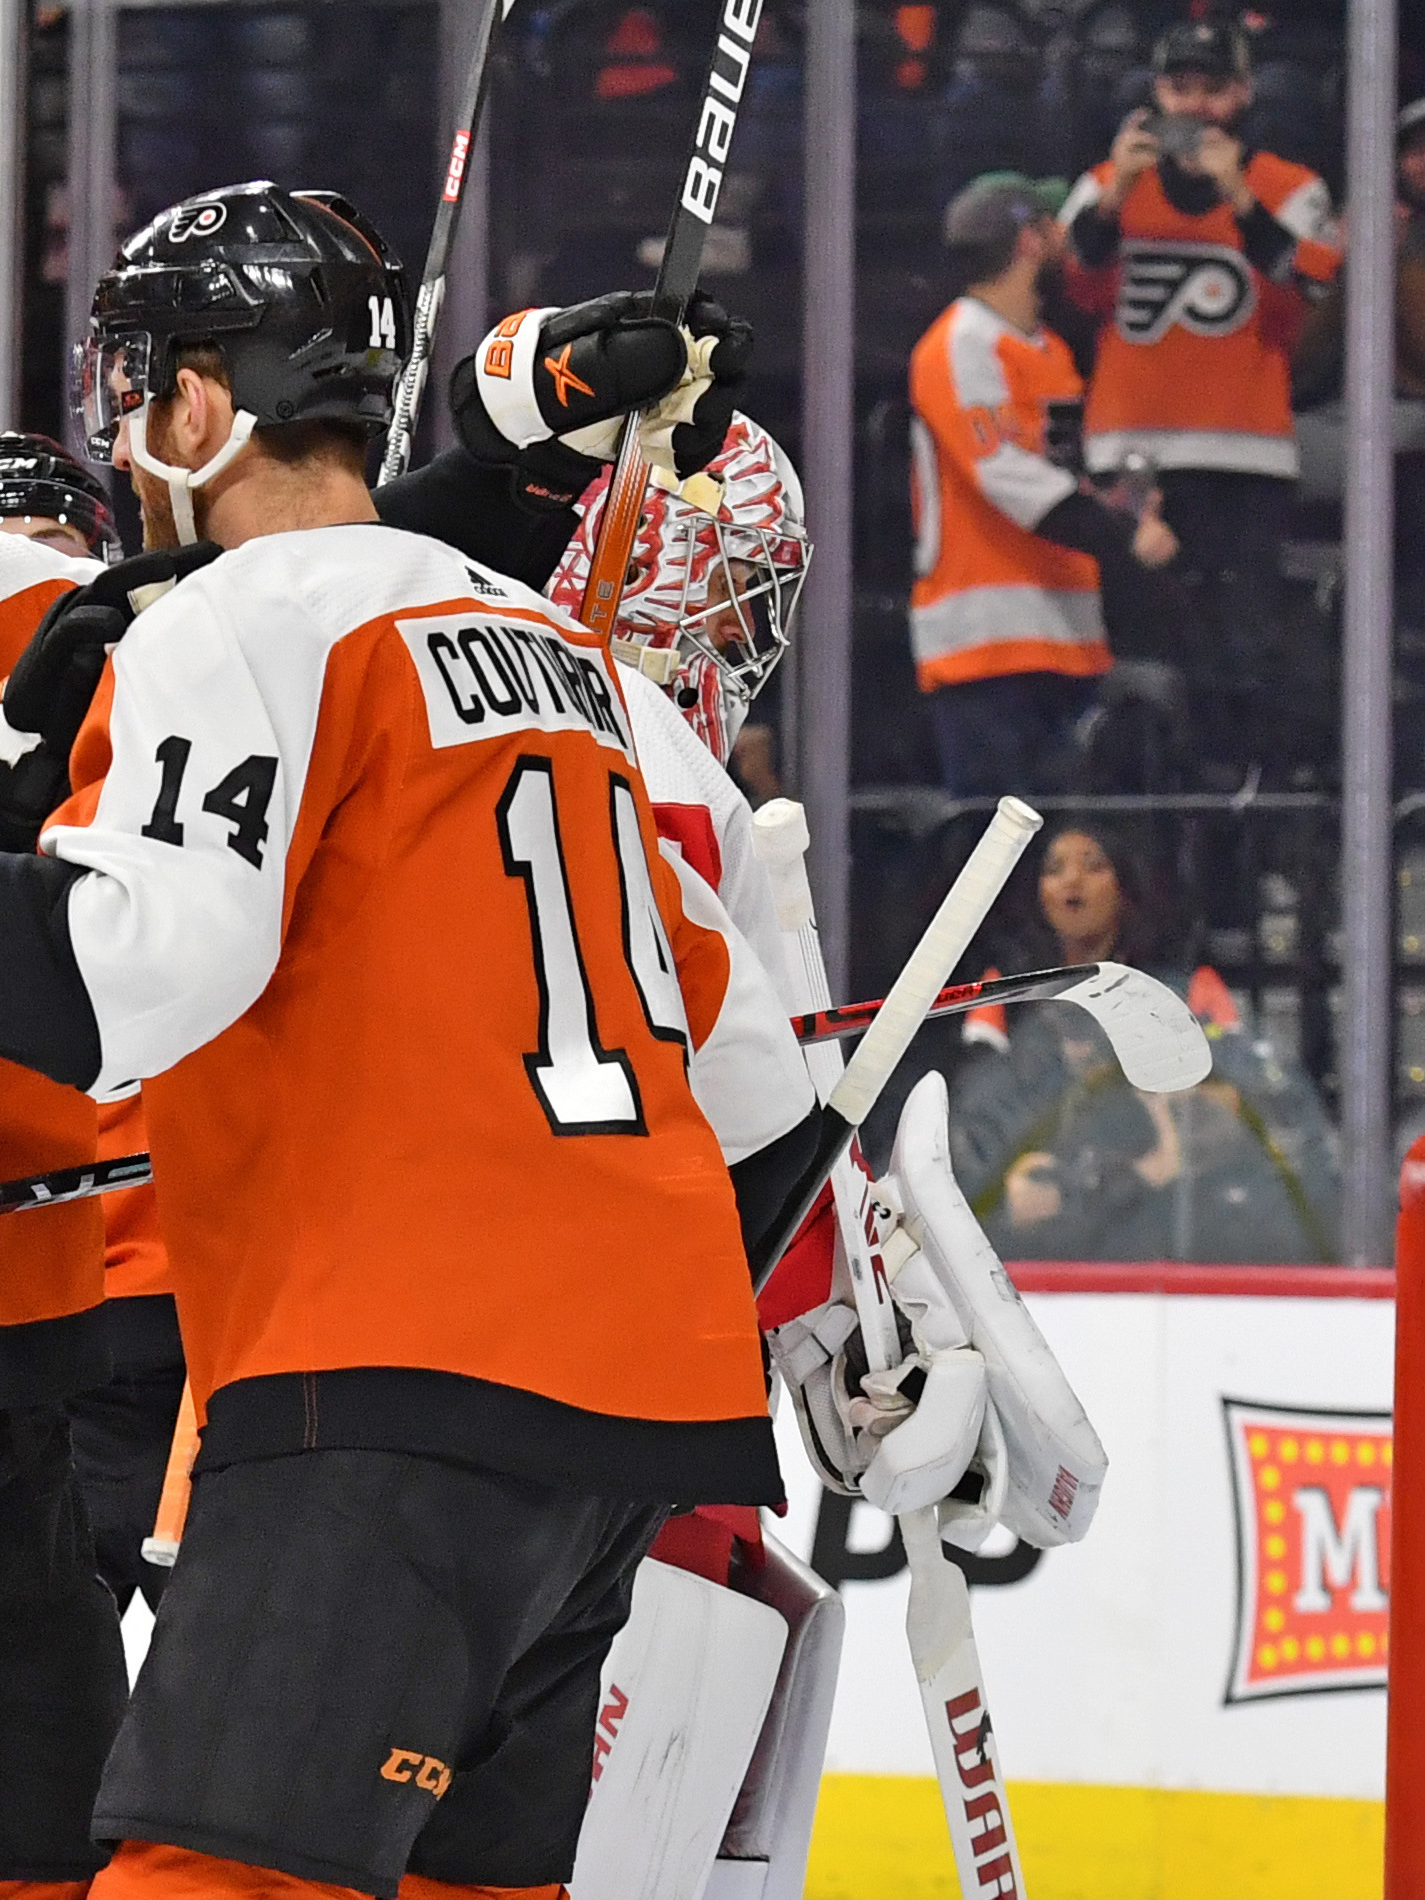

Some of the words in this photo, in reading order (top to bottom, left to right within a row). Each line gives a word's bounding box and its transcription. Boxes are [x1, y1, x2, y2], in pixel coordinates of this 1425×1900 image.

[445, 132, 470, 198] CCM
[368, 295, 397, 350] 14
[141, 735, 279, 871] 14
